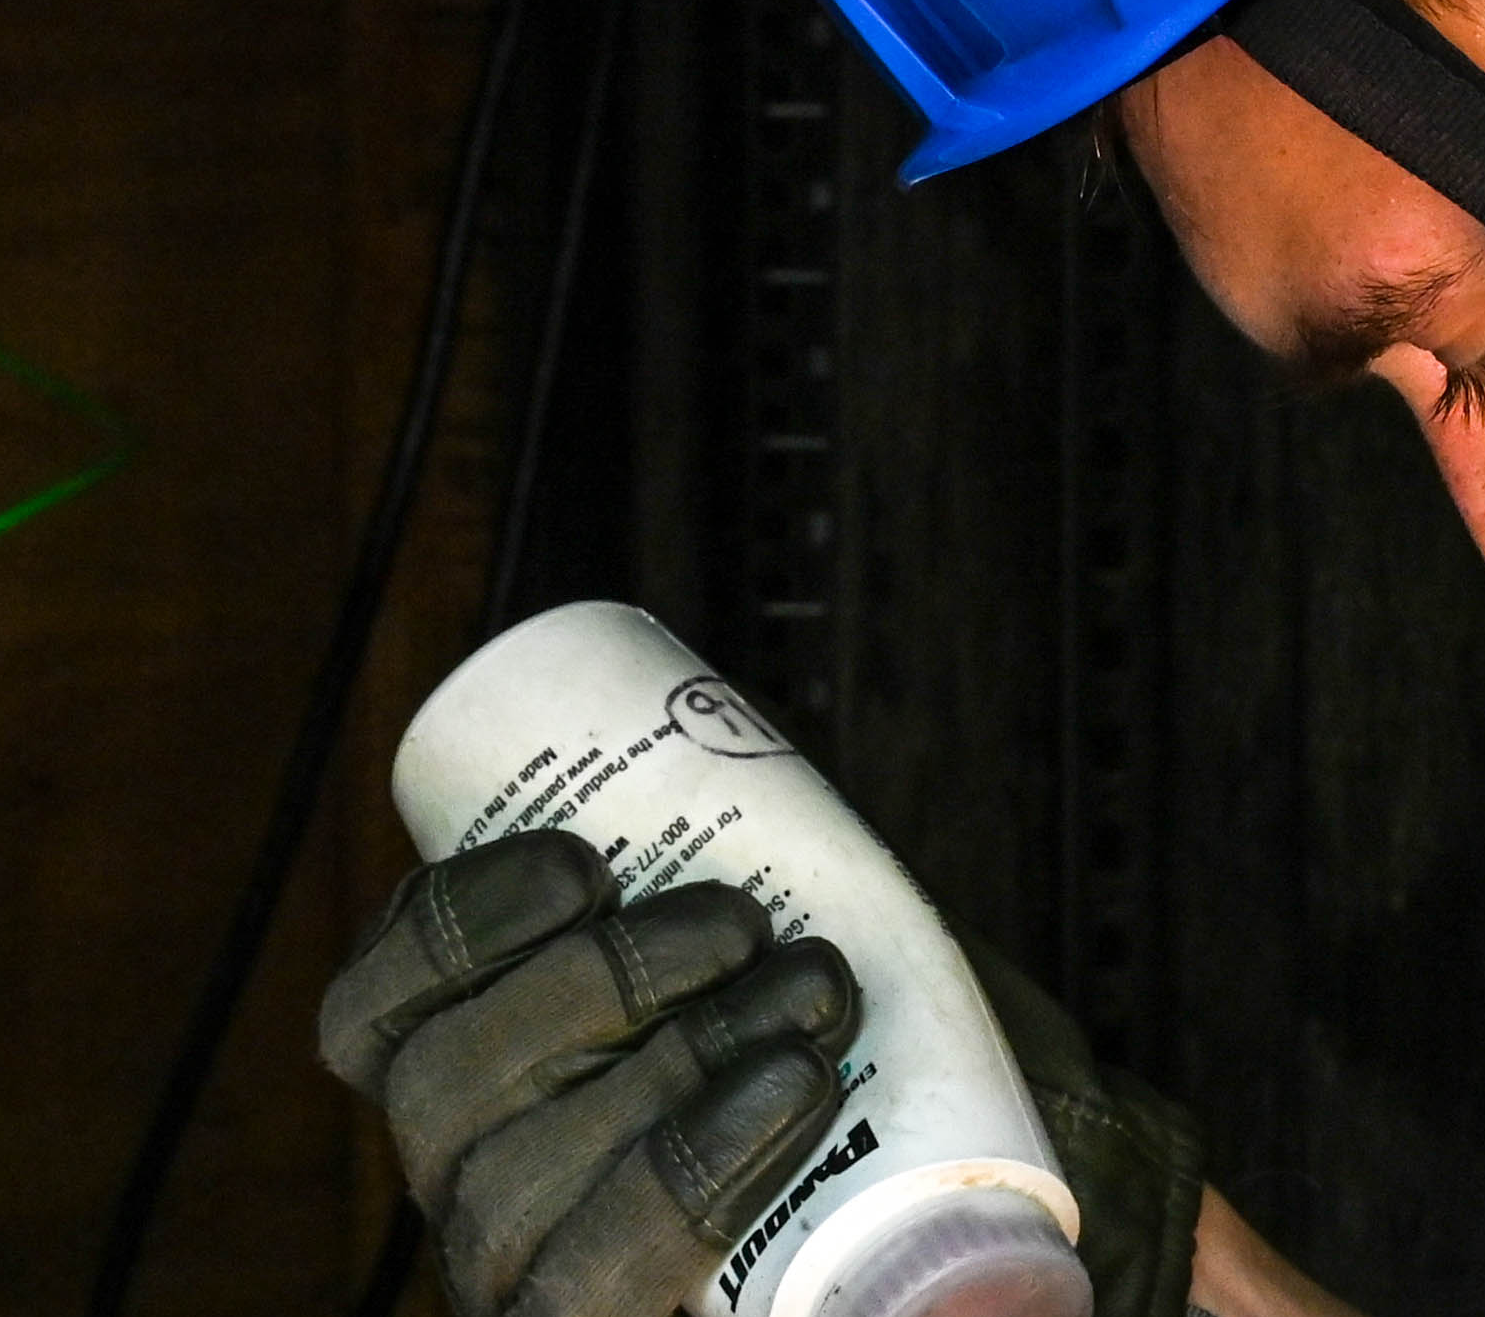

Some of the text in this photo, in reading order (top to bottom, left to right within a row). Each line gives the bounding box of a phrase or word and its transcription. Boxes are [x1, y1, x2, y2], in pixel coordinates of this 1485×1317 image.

[653, 719, 684, 741] See
[627, 737, 653, 759] the
[518, 746, 558, 784] Made
[574, 755, 629, 805] Panduit
[500, 746, 603, 840] www.panduit.co
[504, 781, 522, 798] in
[484, 795, 508, 820] the
[717, 805, 743, 831] For
[680, 826, 715, 862] more
[719, 1118, 879, 1314] PANDUIT
